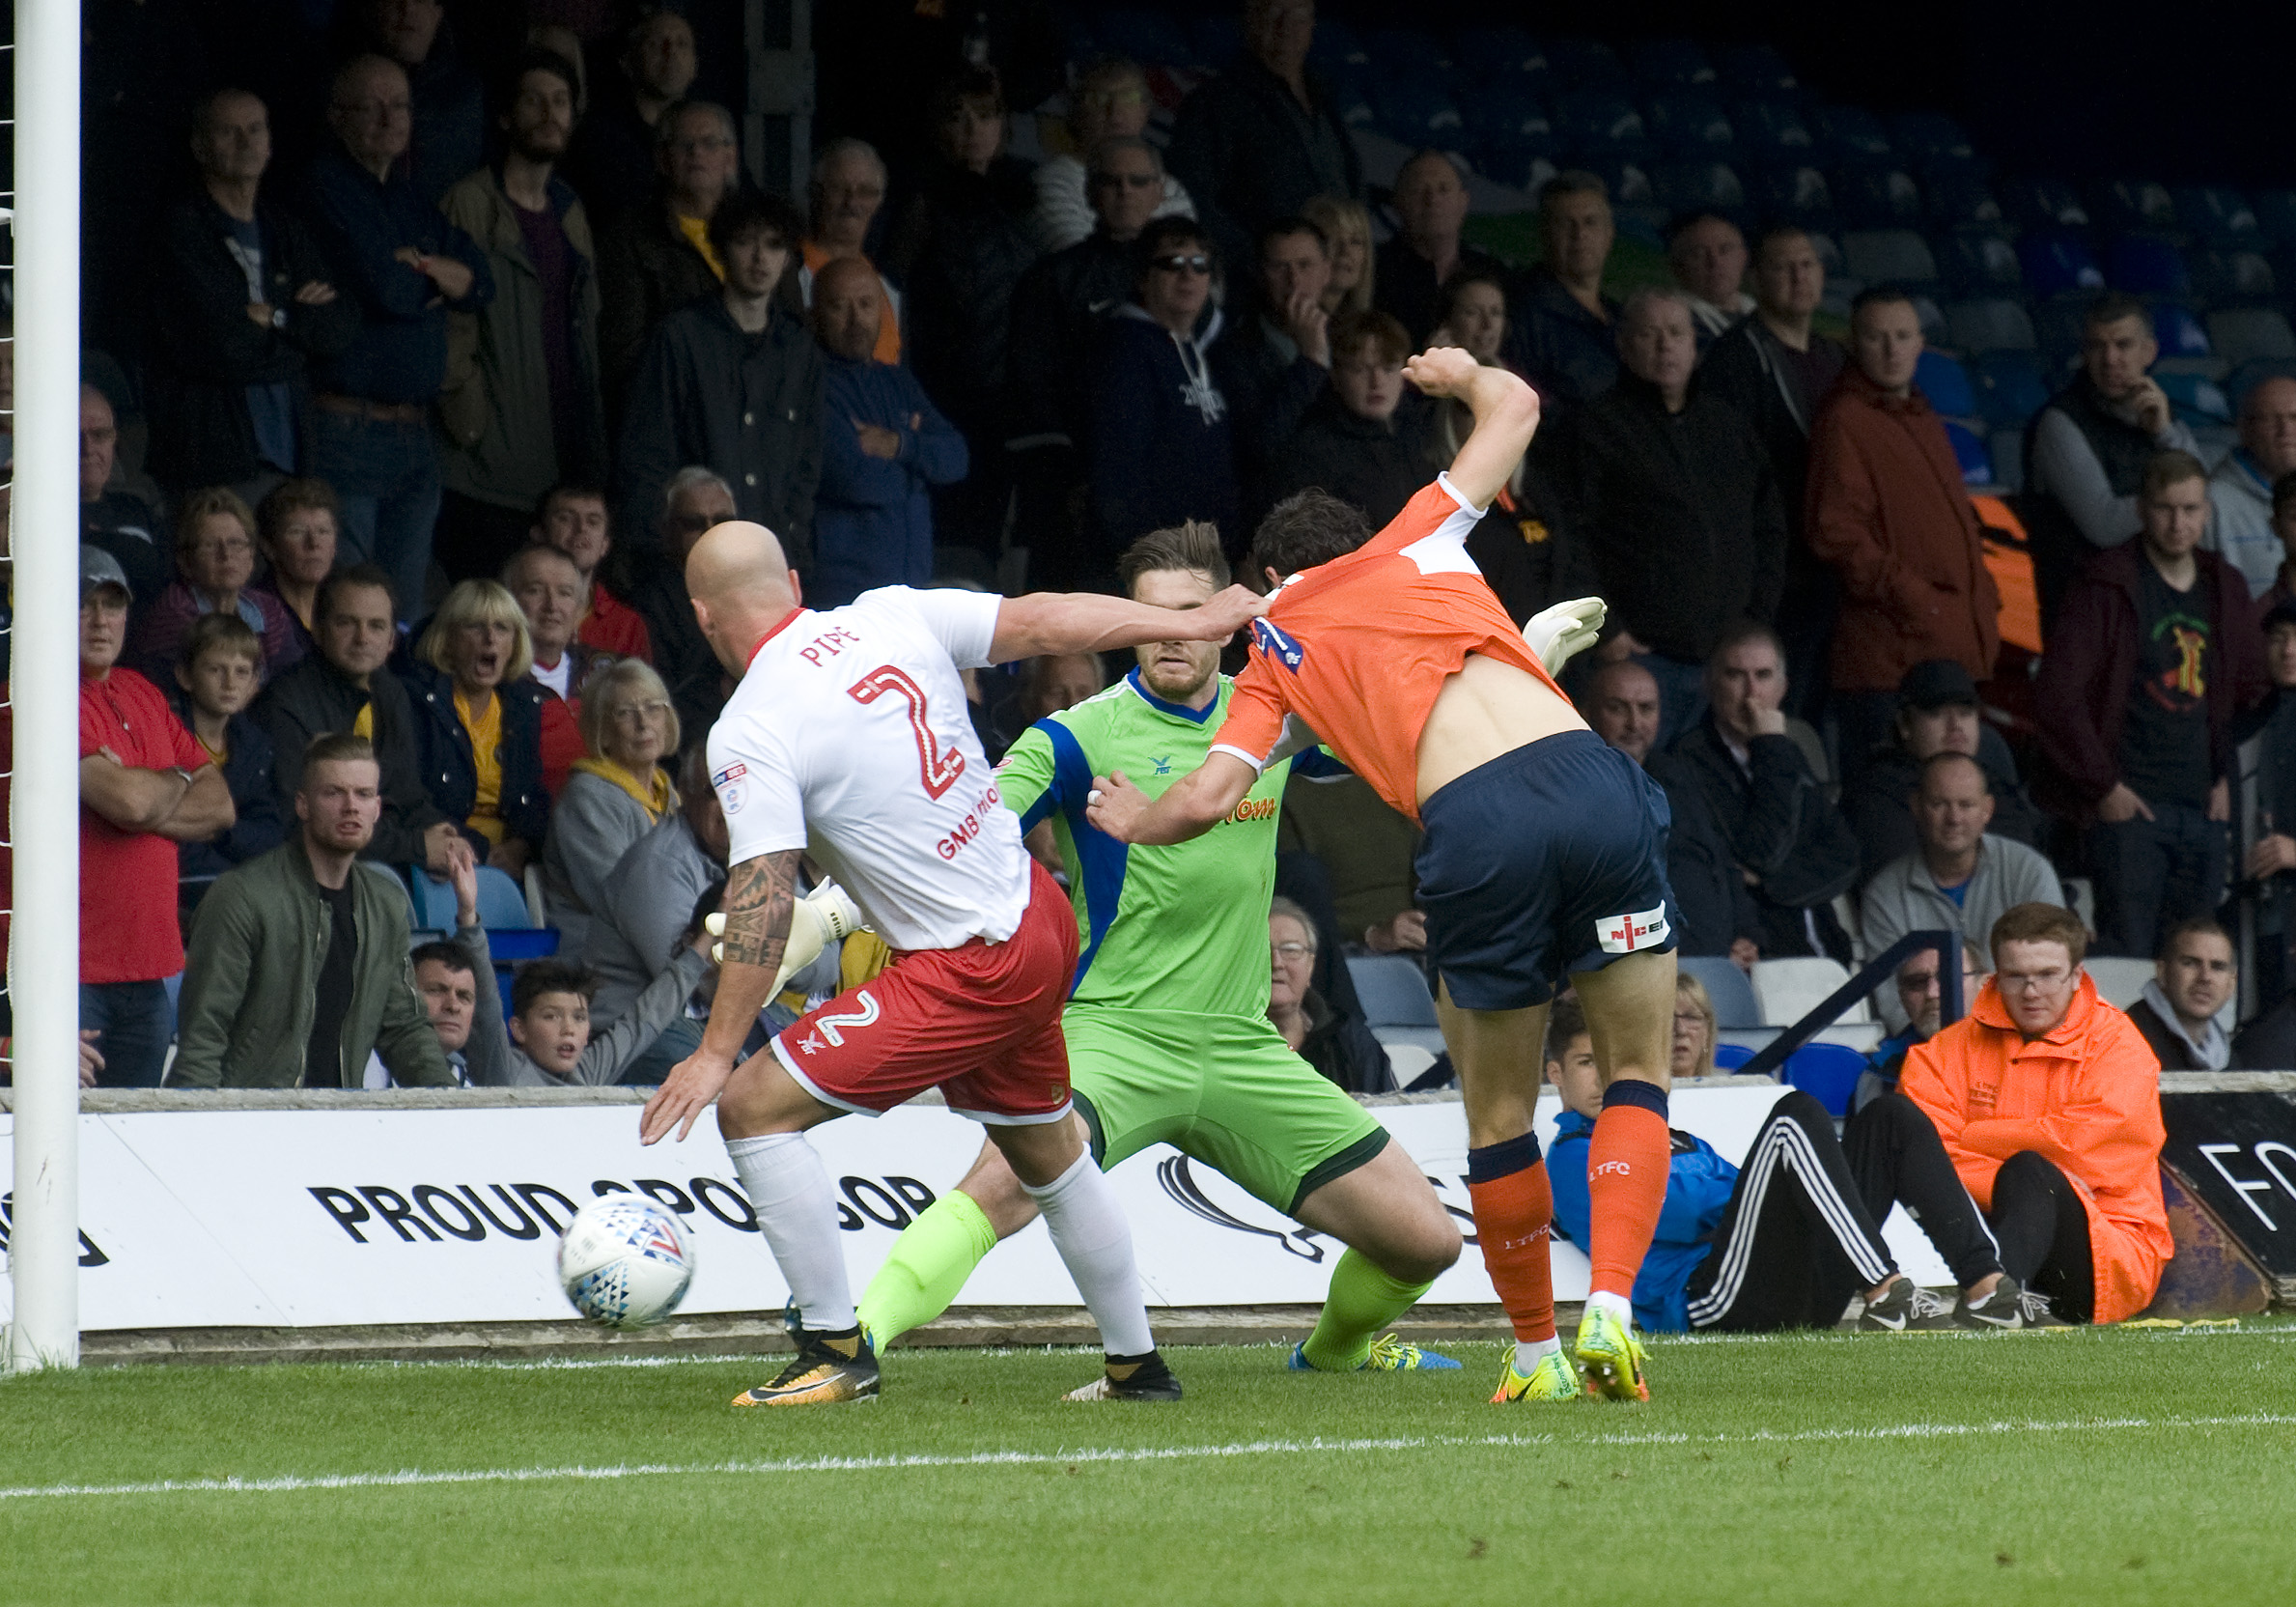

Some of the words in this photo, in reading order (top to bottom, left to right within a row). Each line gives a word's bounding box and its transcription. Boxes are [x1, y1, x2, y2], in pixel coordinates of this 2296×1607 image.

[847, 664, 966, 802] 2
[1224, 797, 1276, 825] om
[937, 814, 980, 860] GMB
[815, 990, 880, 1047] 2
[1588, 1161, 1631, 1183] LTFC
[306, 1182, 579, 1244] PROUD
